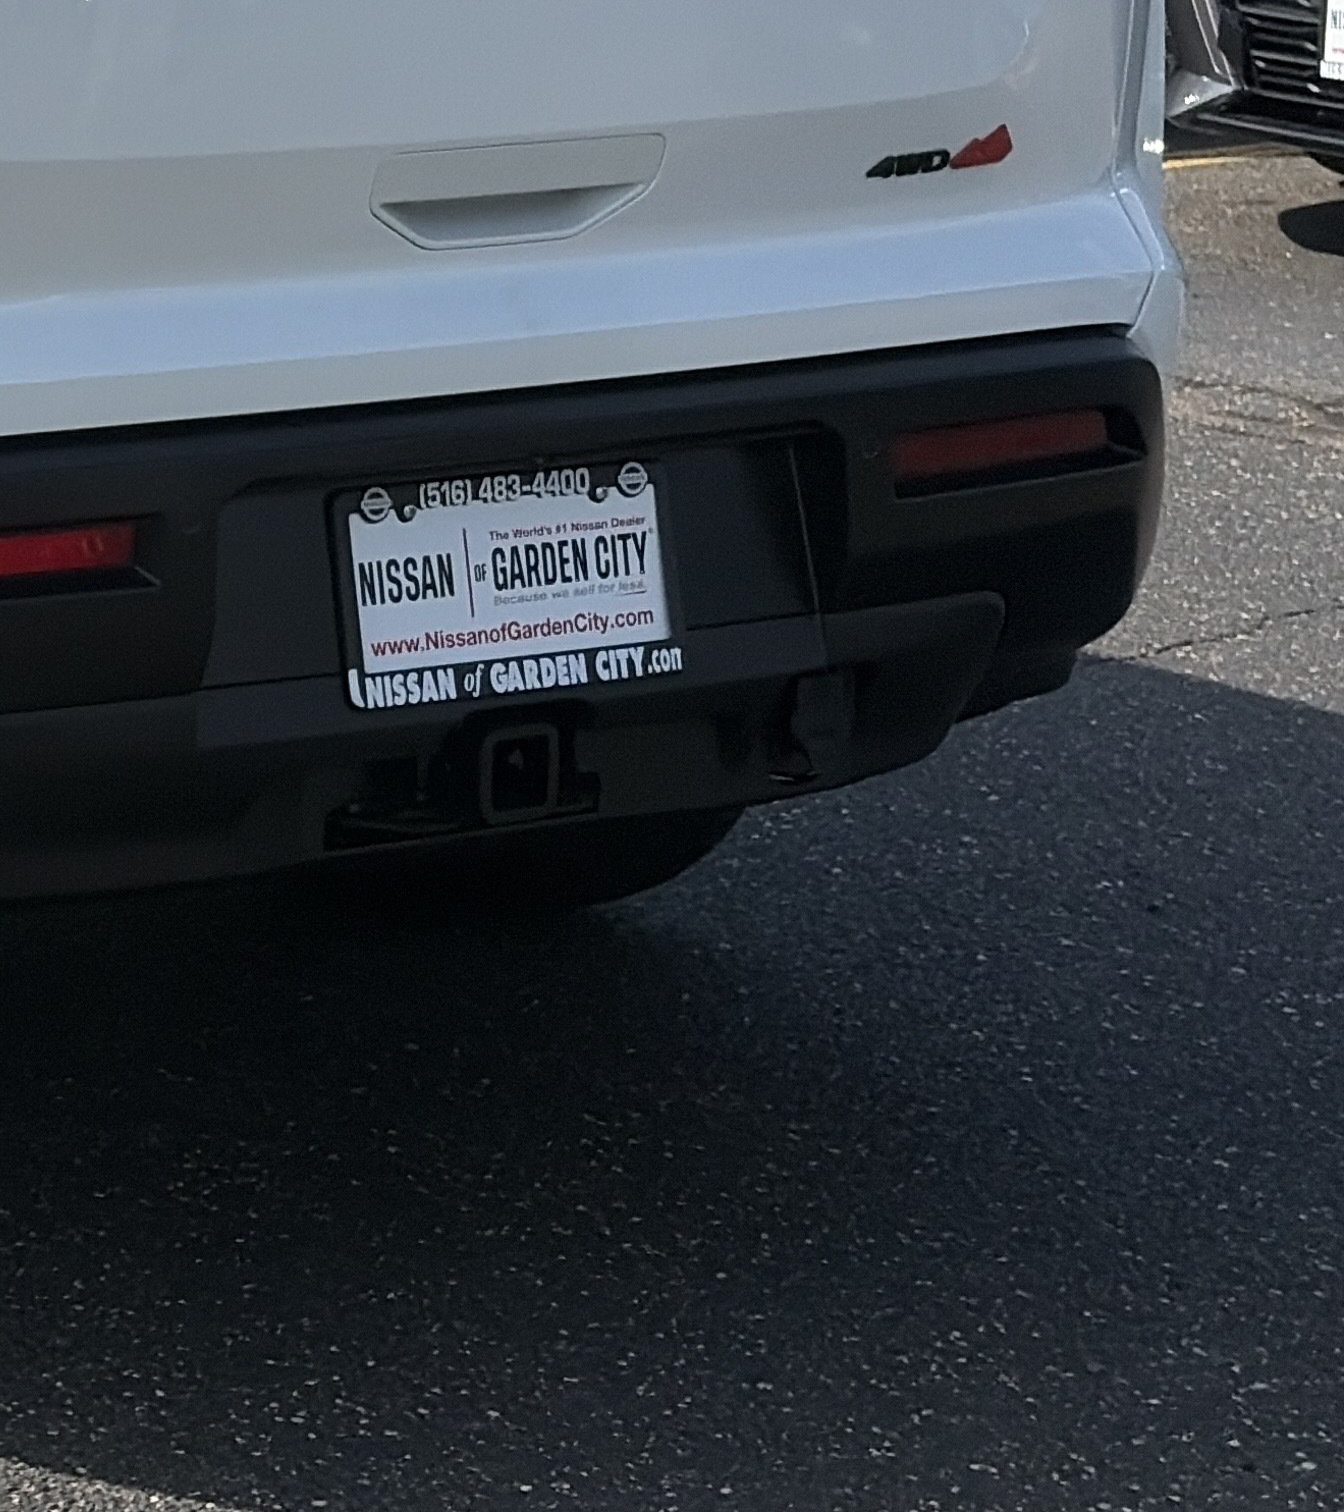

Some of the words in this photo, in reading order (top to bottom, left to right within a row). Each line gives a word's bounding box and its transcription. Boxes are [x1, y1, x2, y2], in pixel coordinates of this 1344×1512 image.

[419, 478, 472, 509] (516)
[478, 467, 590, 502] 483-4400
[489, 530, 510, 541] The
[512, 525, 553, 539] World's
[555, 522, 567, 534] #1
[571, 519, 608, 533] Nissan
[611, 516, 646, 528] Dealer
[358, 552, 456, 608] NISSAN
[473, 563, 488, 584] OF
[490, 536, 589, 592] GARDEN
[593, 530, 648, 580] CITY
[370, 607, 655, 658] www.NissanofGardenCity.com
[363, 665, 458, 709] NISSAN
[463, 663, 486, 699] of
[489, 652, 589, 695] GARDEN
